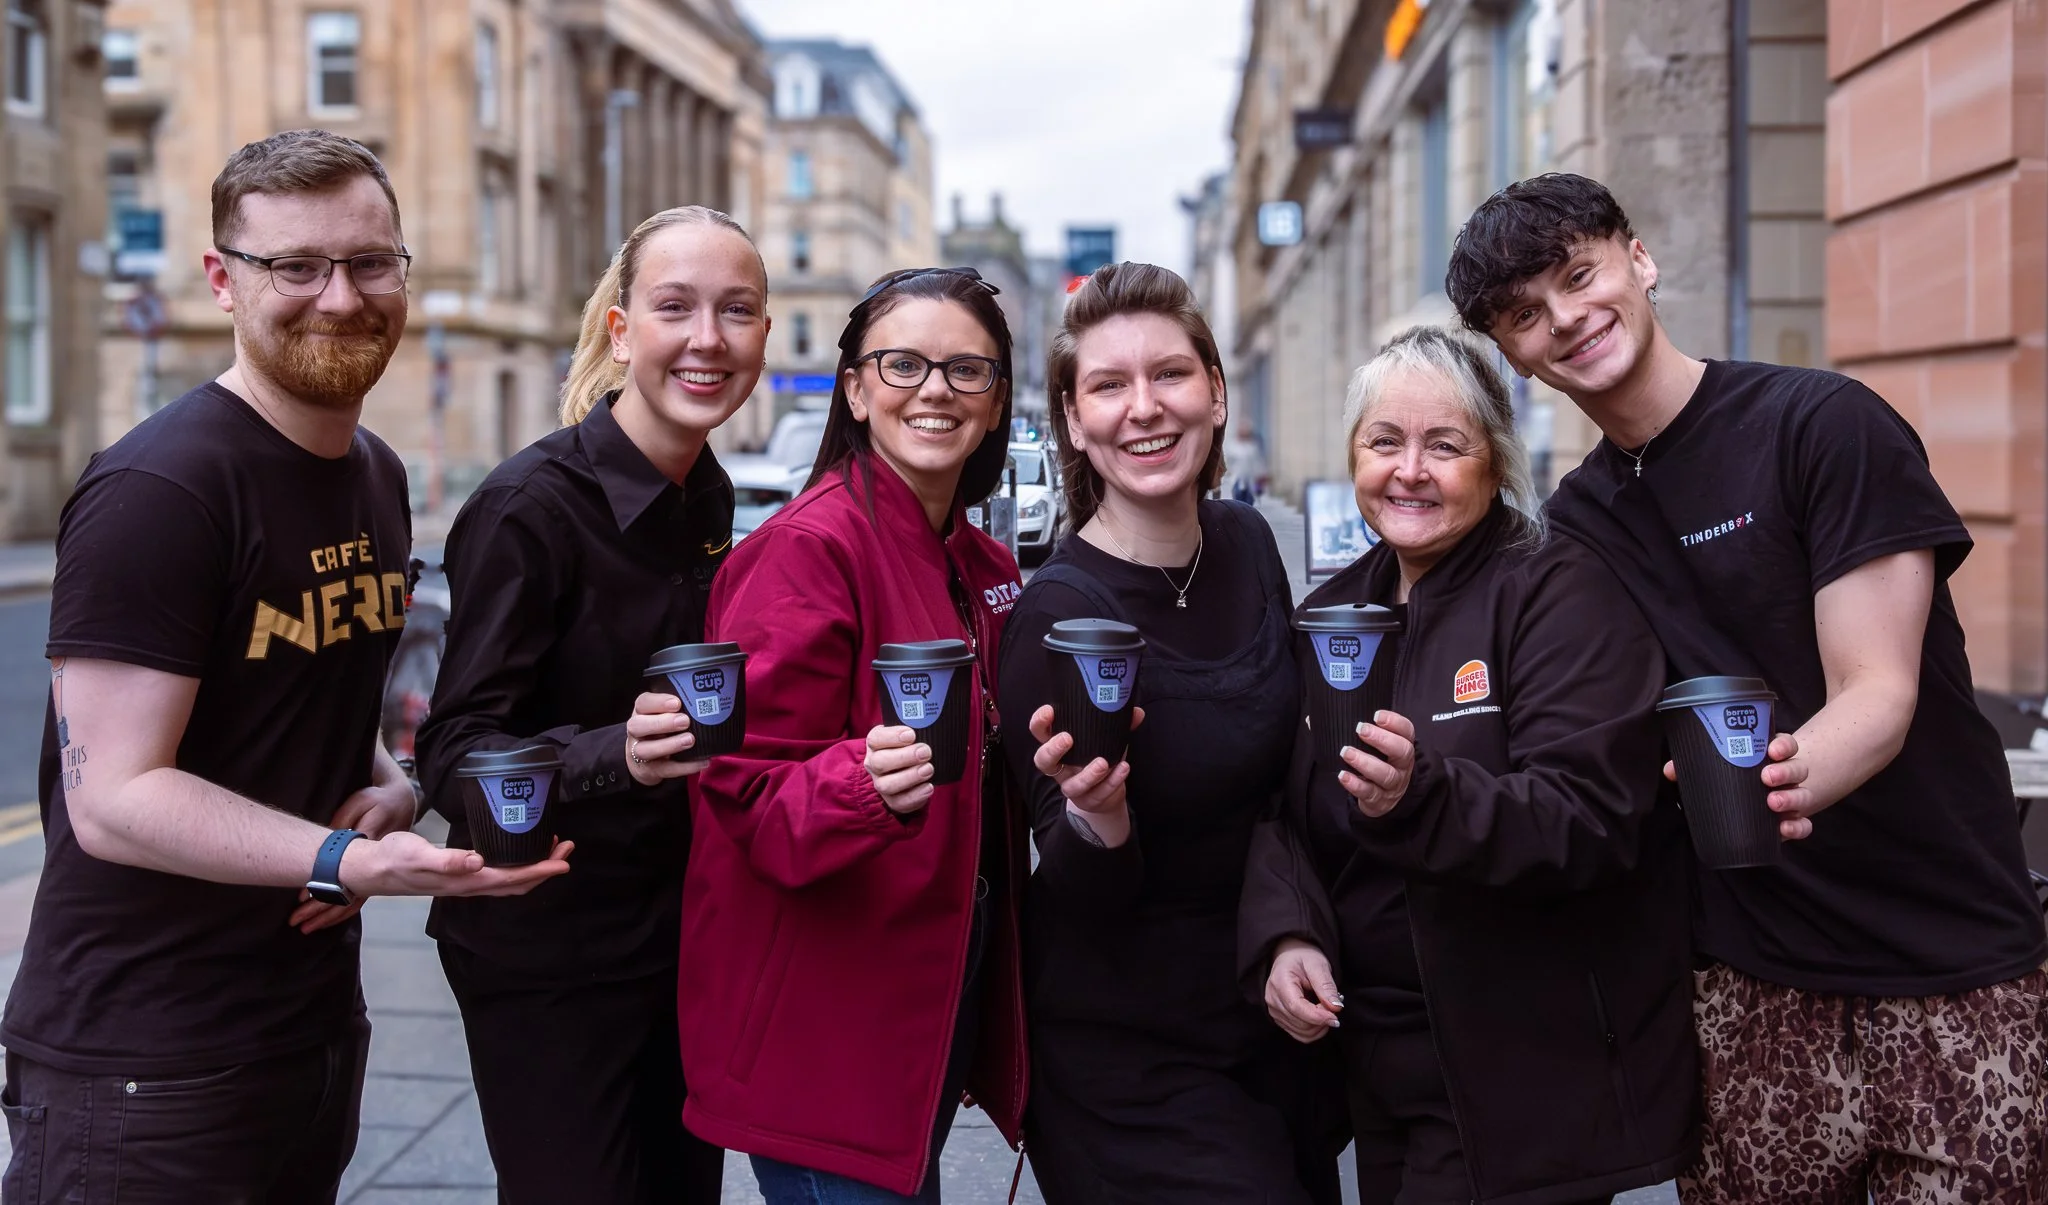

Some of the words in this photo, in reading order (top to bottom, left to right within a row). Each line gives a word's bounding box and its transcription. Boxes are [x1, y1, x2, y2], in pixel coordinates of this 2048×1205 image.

[694, 671, 722, 680] borrow
[1456, 670, 1486, 686] BURGER
[1456, 679, 1488, 696] KING
[1726, 709, 1755, 717] borrow
